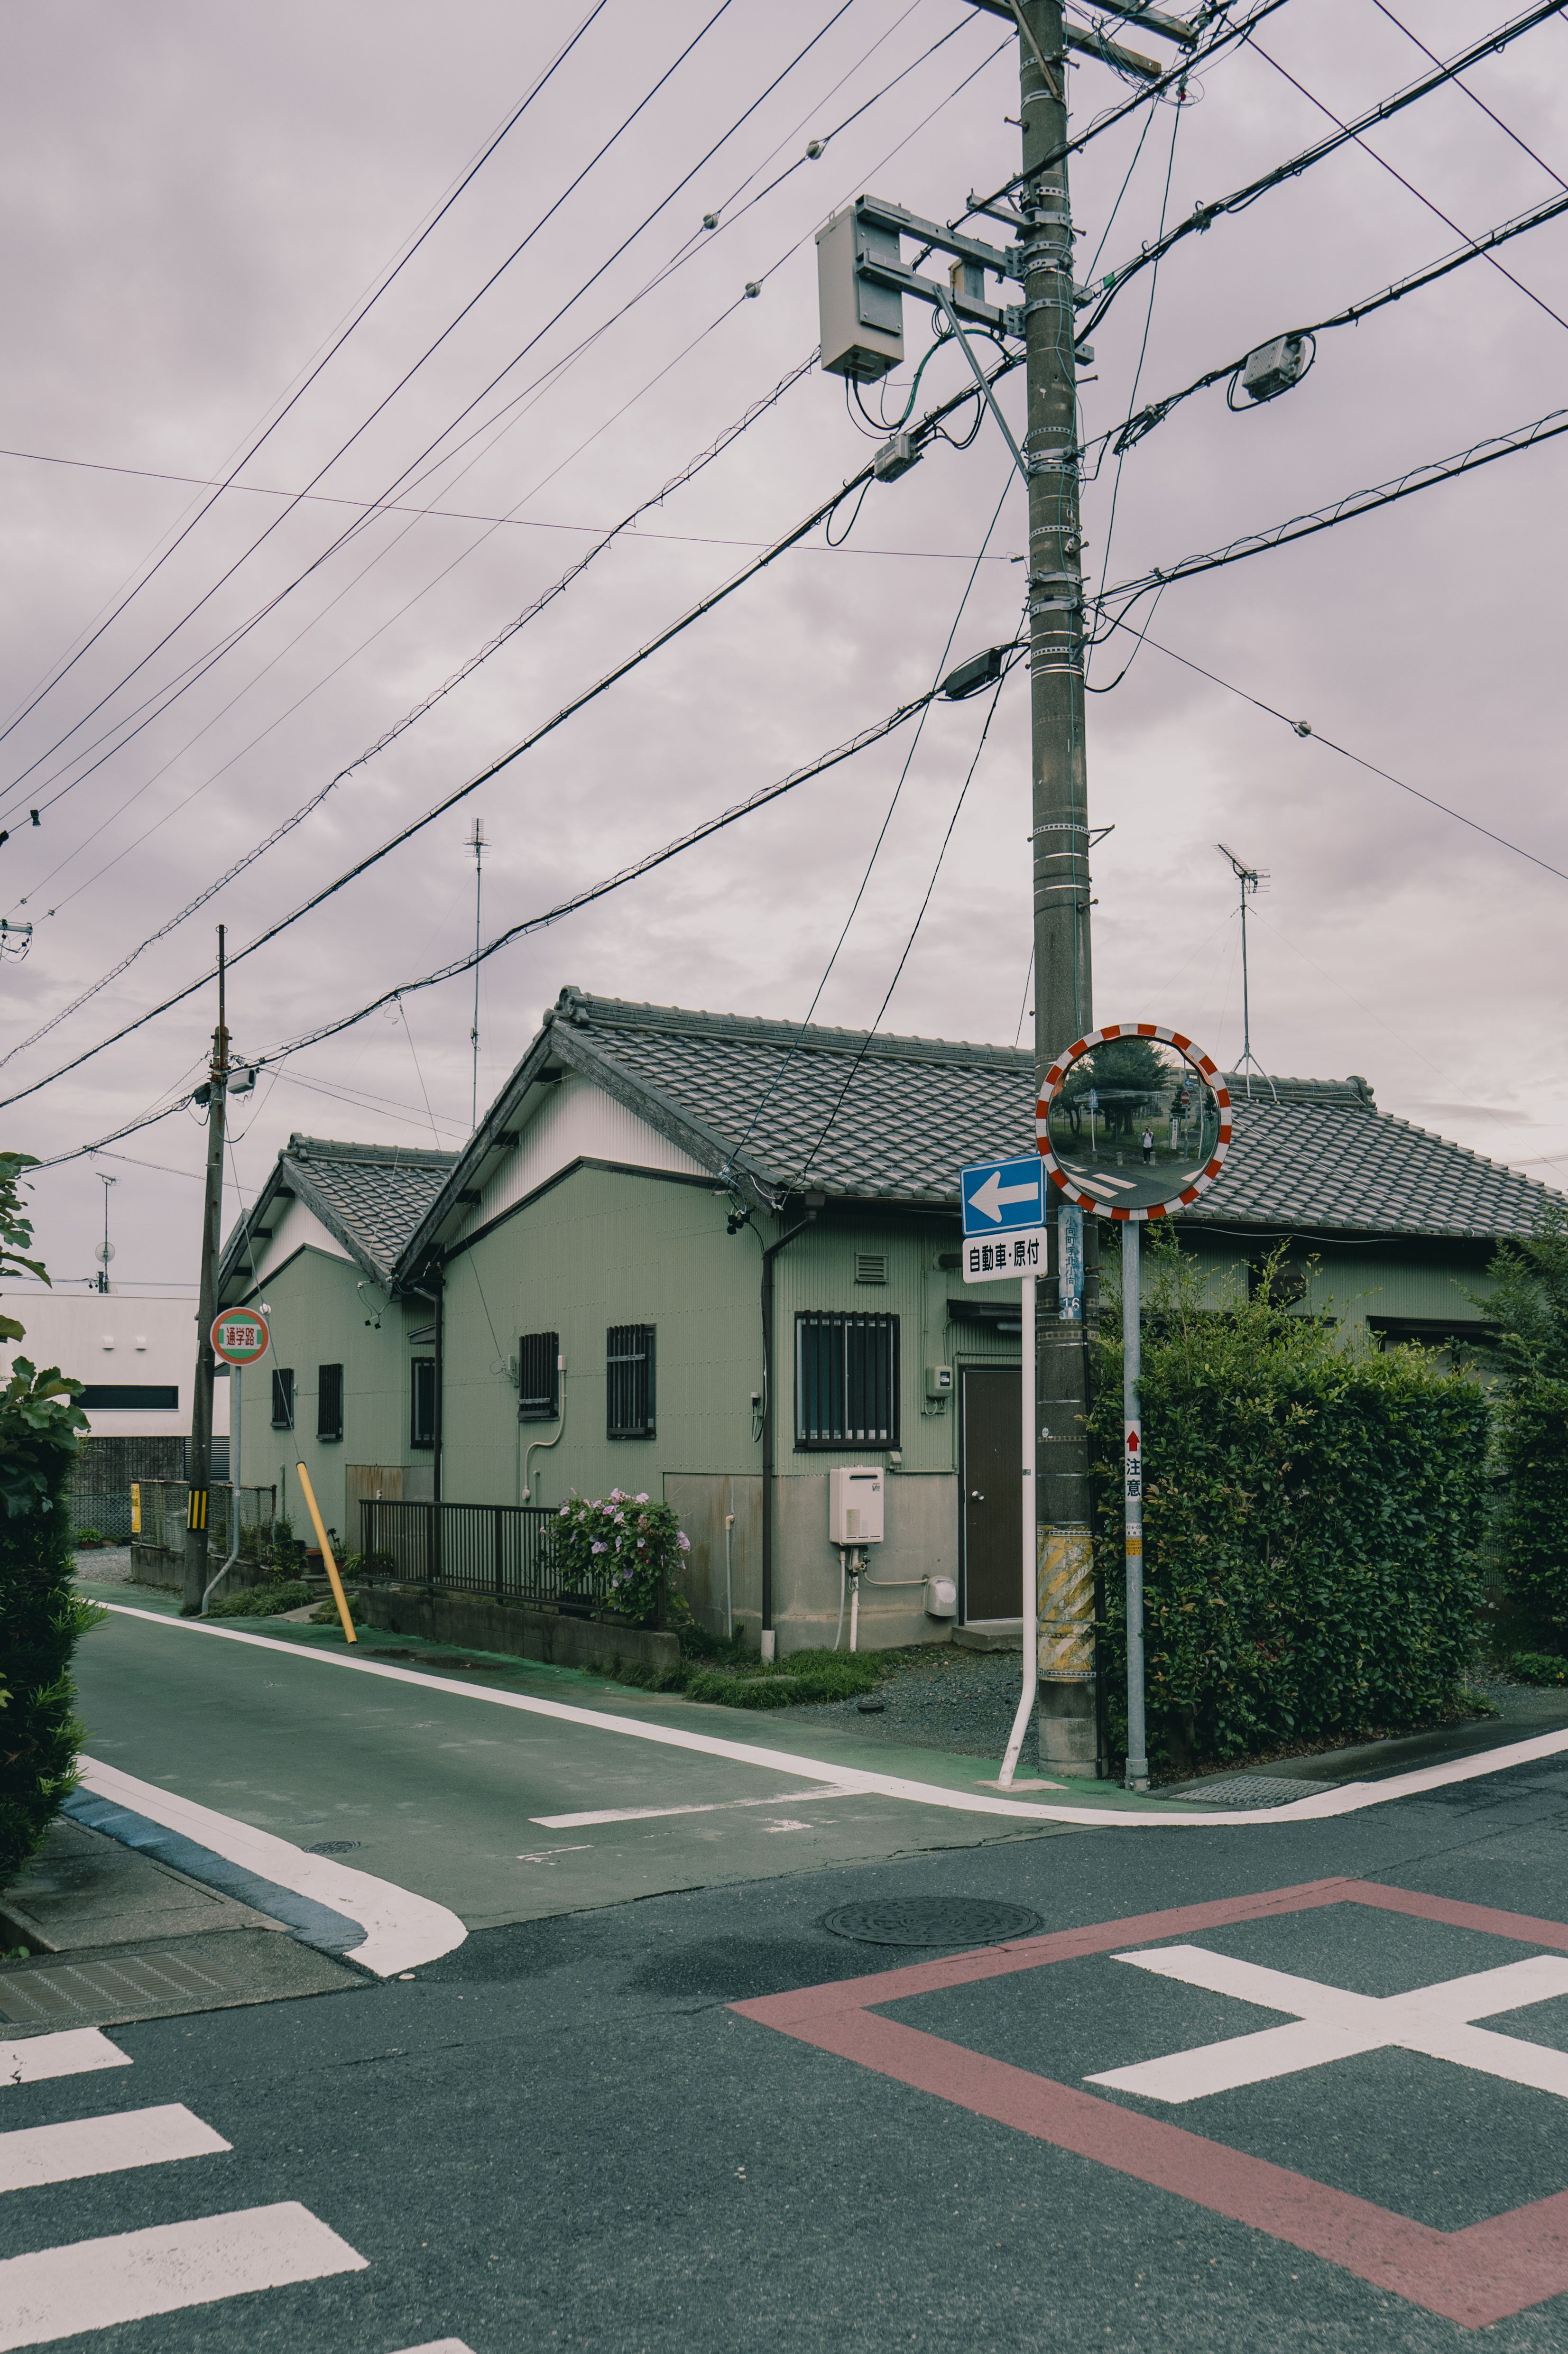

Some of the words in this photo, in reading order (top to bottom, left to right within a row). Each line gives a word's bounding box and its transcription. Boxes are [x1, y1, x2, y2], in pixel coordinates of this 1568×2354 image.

[970, 1238, 1039, 1272] 自動車・原付
[1065, 1216, 1077, 1286] 小向町字北小向
[1063, 1297, 1079, 1311] 16
[227, 1328, 254, 1346] 通学路
[1126, 1458, 1141, 1496] 注意
